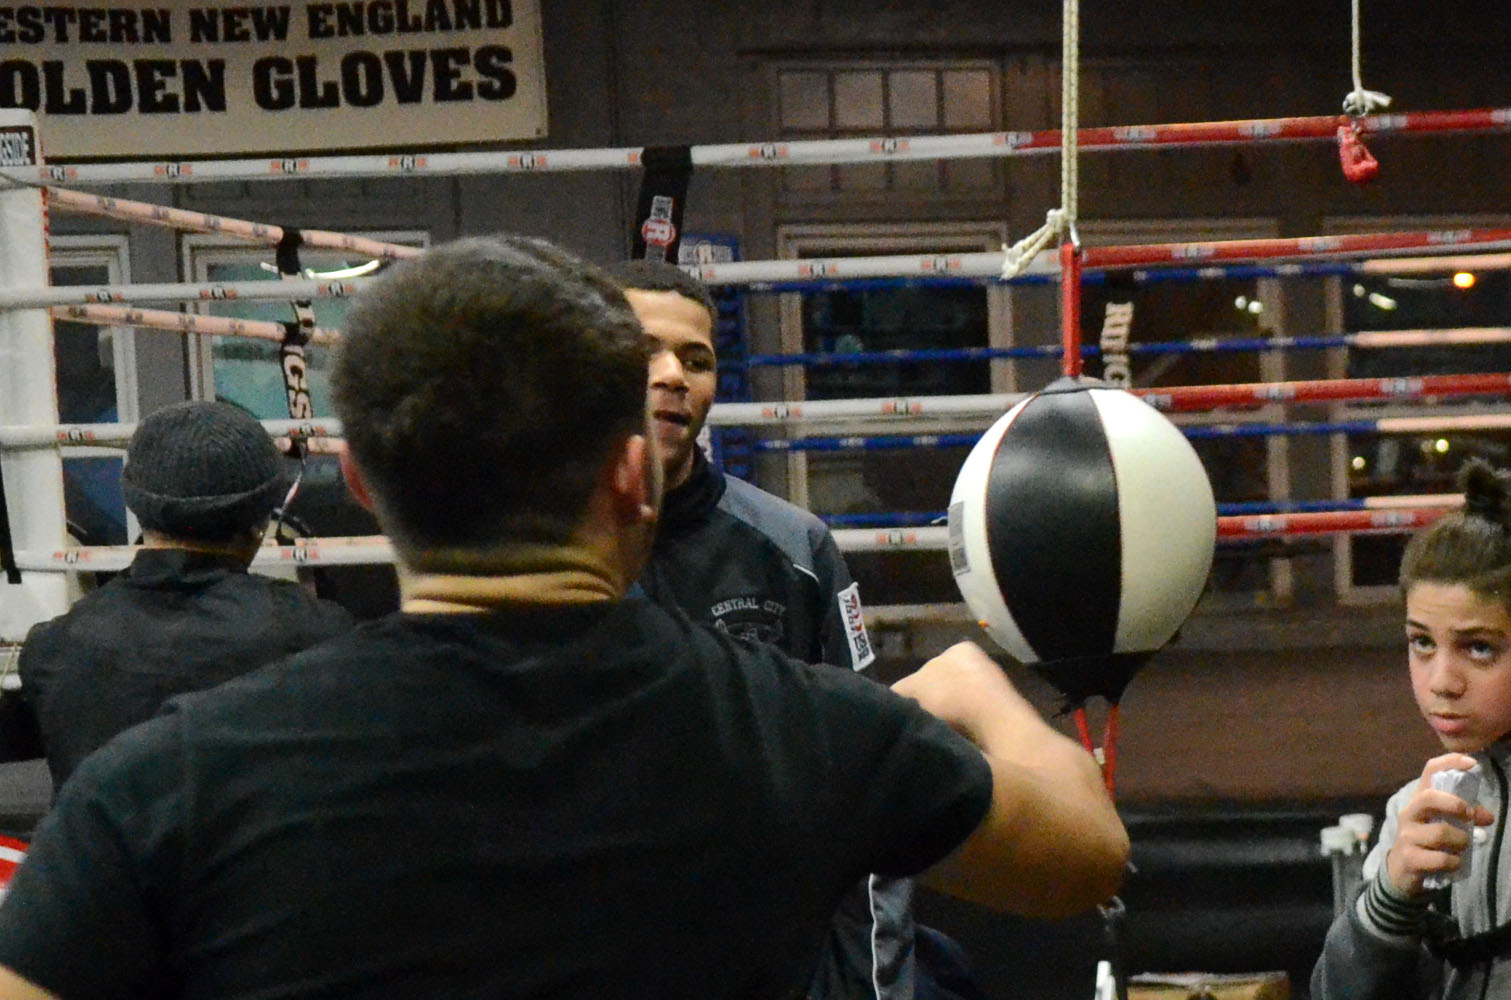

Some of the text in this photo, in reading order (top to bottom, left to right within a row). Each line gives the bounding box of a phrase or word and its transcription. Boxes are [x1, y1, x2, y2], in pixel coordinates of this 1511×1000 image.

[189, 5, 291, 43] NEW
[307, 0, 513, 39] ENGLAND
[0, 44, 518, 115] OLDEN GLOVES
[711, 597, 759, 617] CENTRAL
